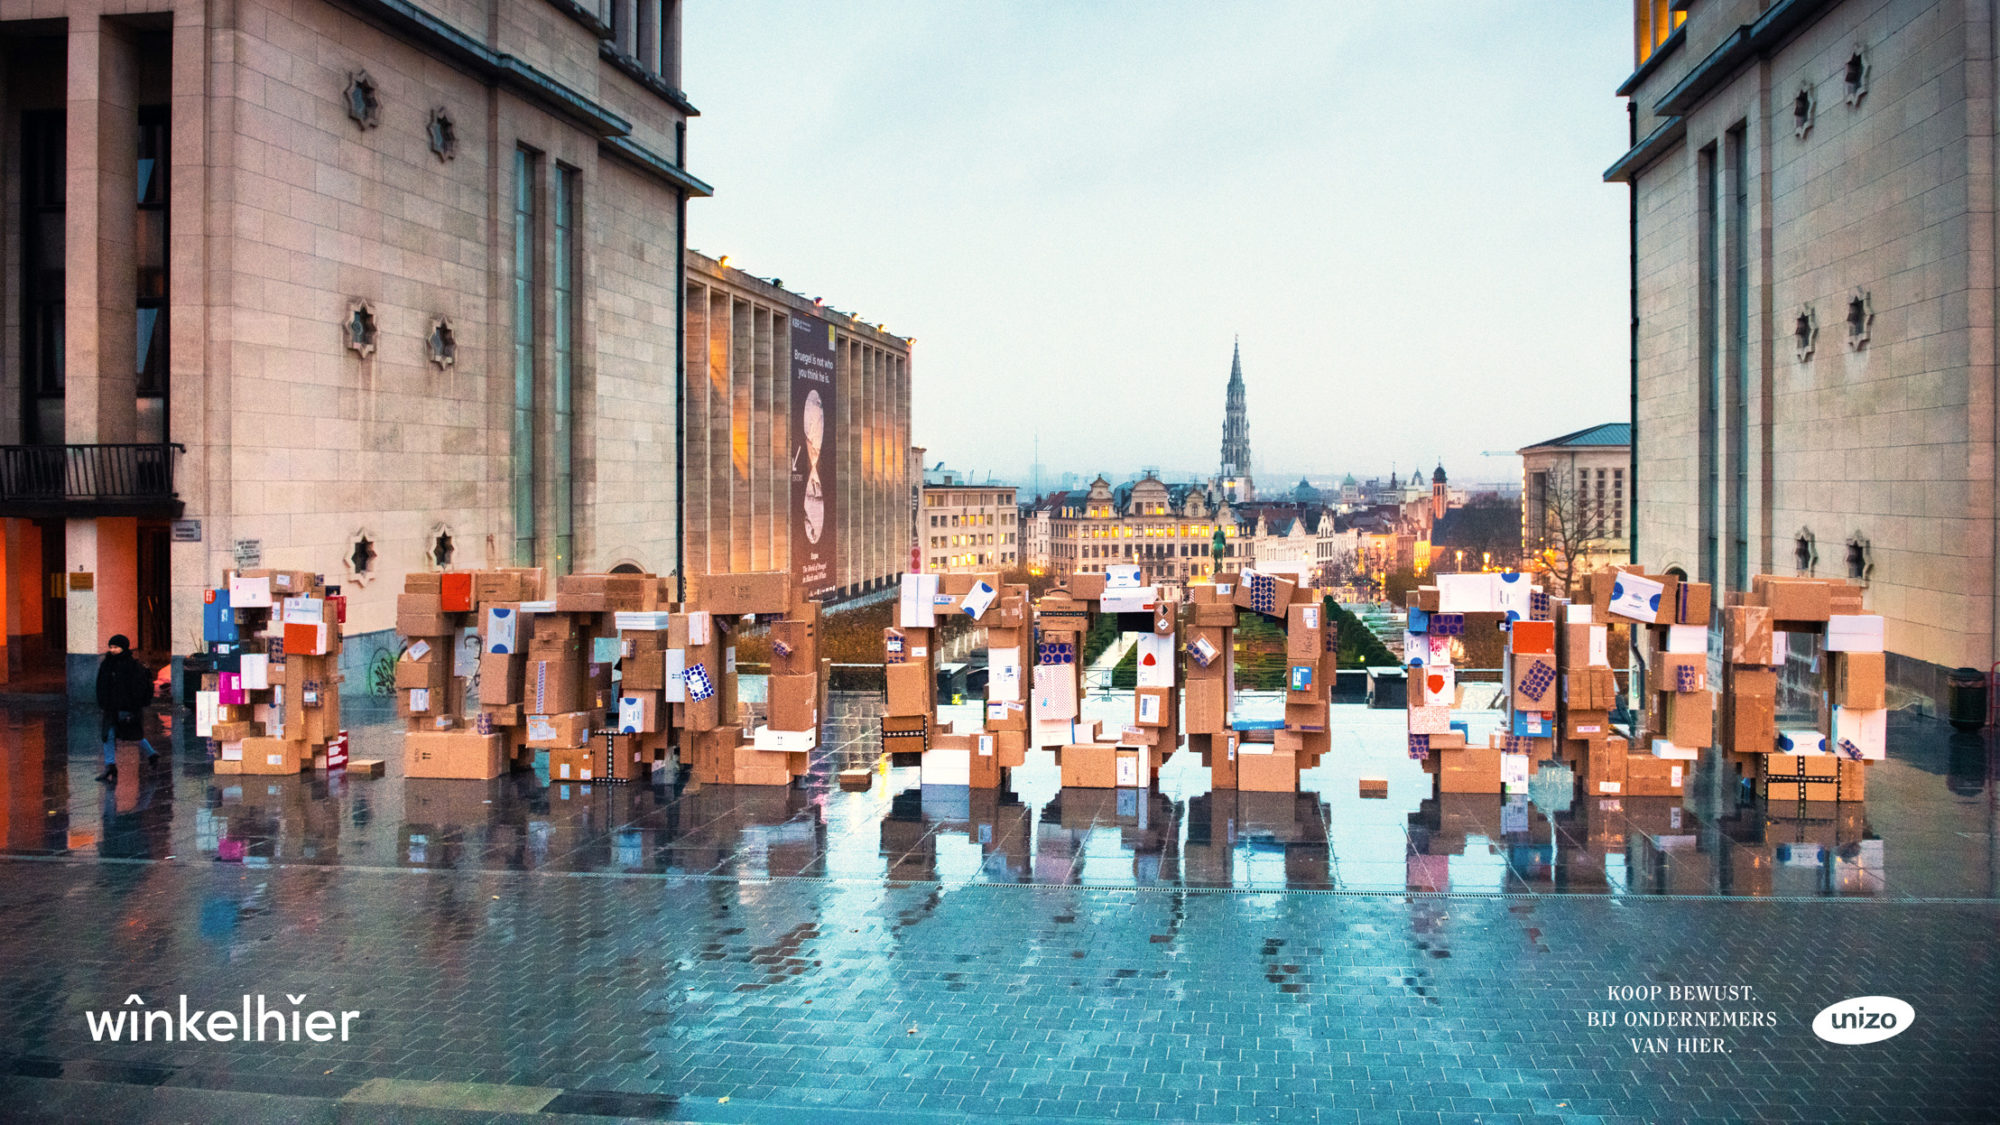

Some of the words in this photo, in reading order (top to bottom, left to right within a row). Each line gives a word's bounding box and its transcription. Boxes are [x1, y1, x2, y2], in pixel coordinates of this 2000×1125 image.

[794, 349, 812, 365] Bruegel
[824, 359, 834, 370] who
[798, 368, 807, 380] you
[807, 369, 819, 380] think
[819, 371, 825, 382] he
